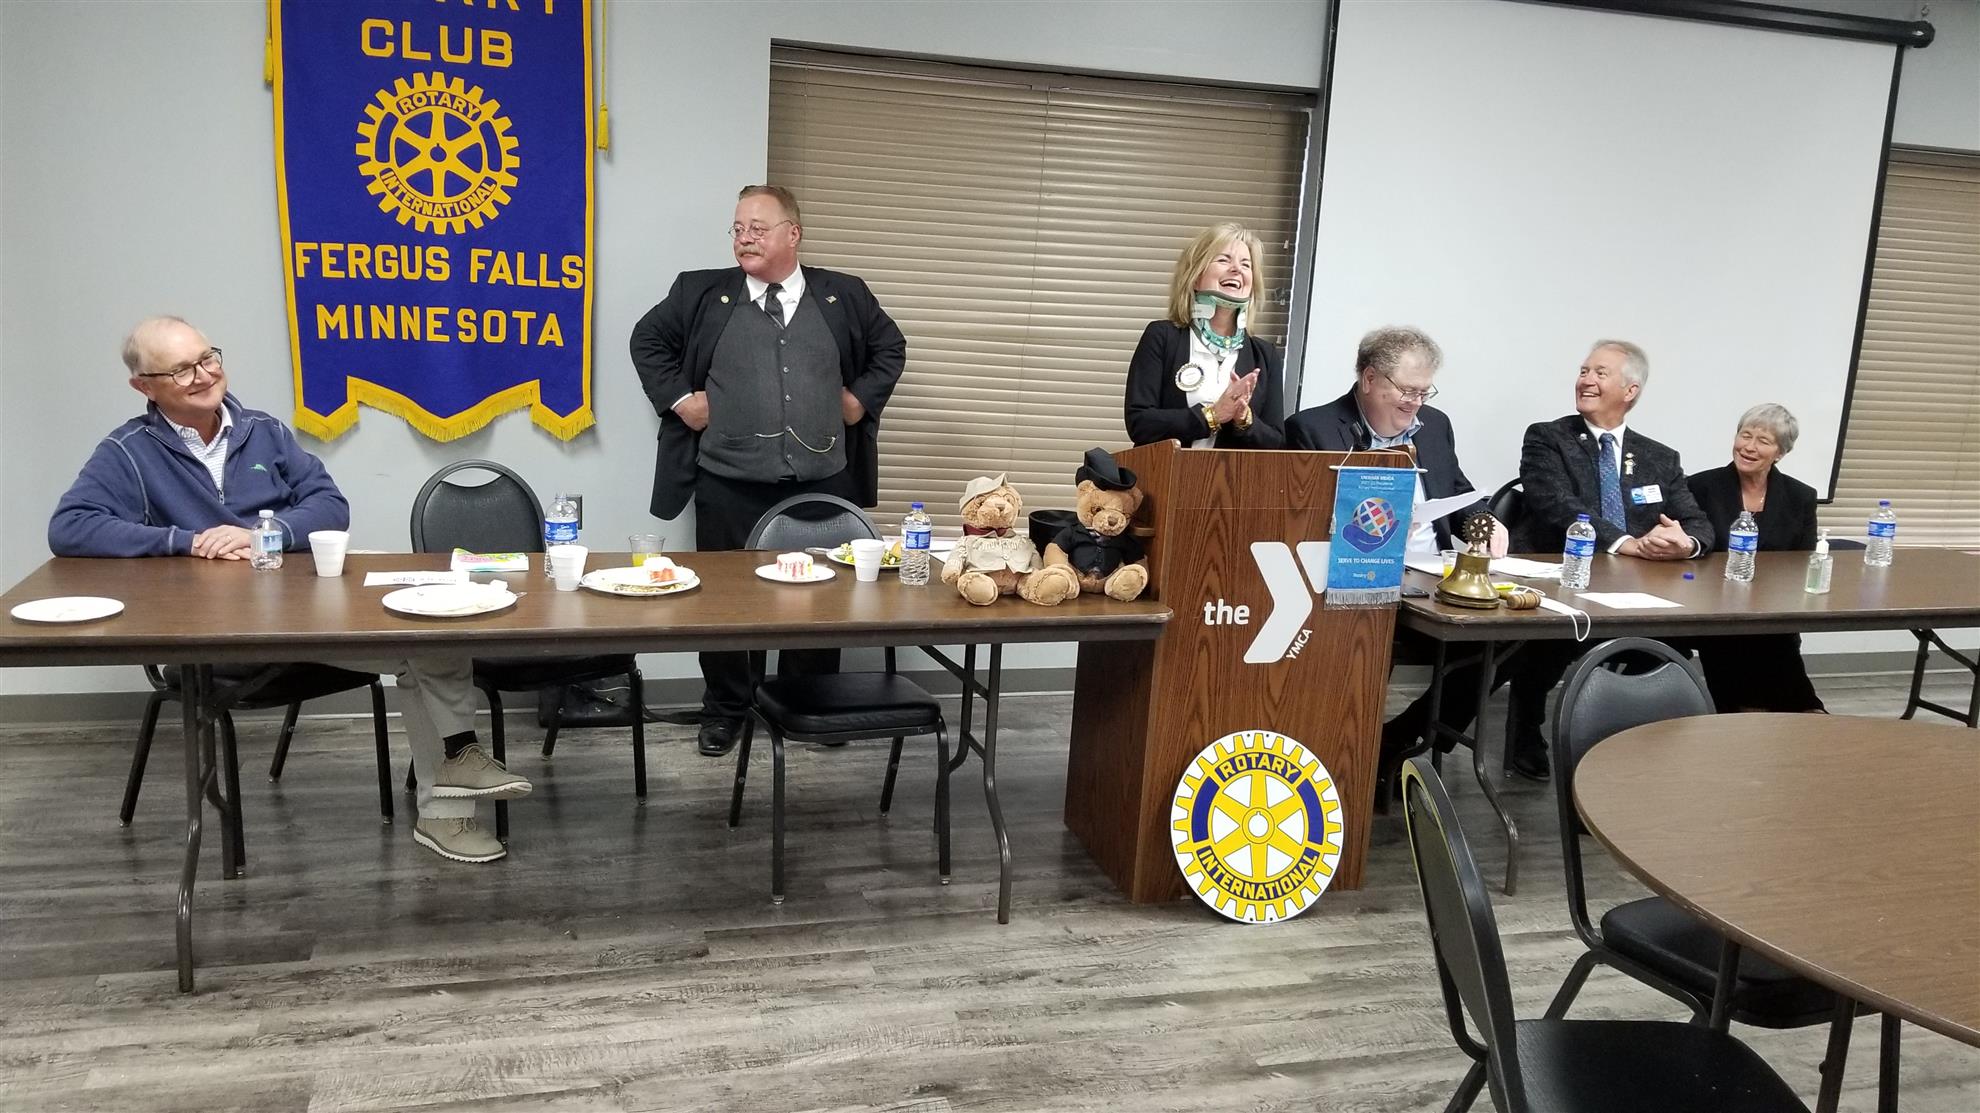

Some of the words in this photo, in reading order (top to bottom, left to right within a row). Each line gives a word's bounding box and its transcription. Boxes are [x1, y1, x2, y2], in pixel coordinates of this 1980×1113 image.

[361, 18, 513, 68] CLUB
[400, 90, 480, 120] ROTARY
[380, 169, 496, 218] INTERNATIONAL
[295, 241, 450, 282] FERGUS
[470, 249, 584, 290] FALLS
[316, 304, 565, 348] MINNESOTA
[1203, 598, 1250, 626] the
[1285, 628, 1313, 661] YMCA
[1219, 753, 1299, 780] ROTARY
[1198, 848, 1318, 900] INTERNATIONAL
